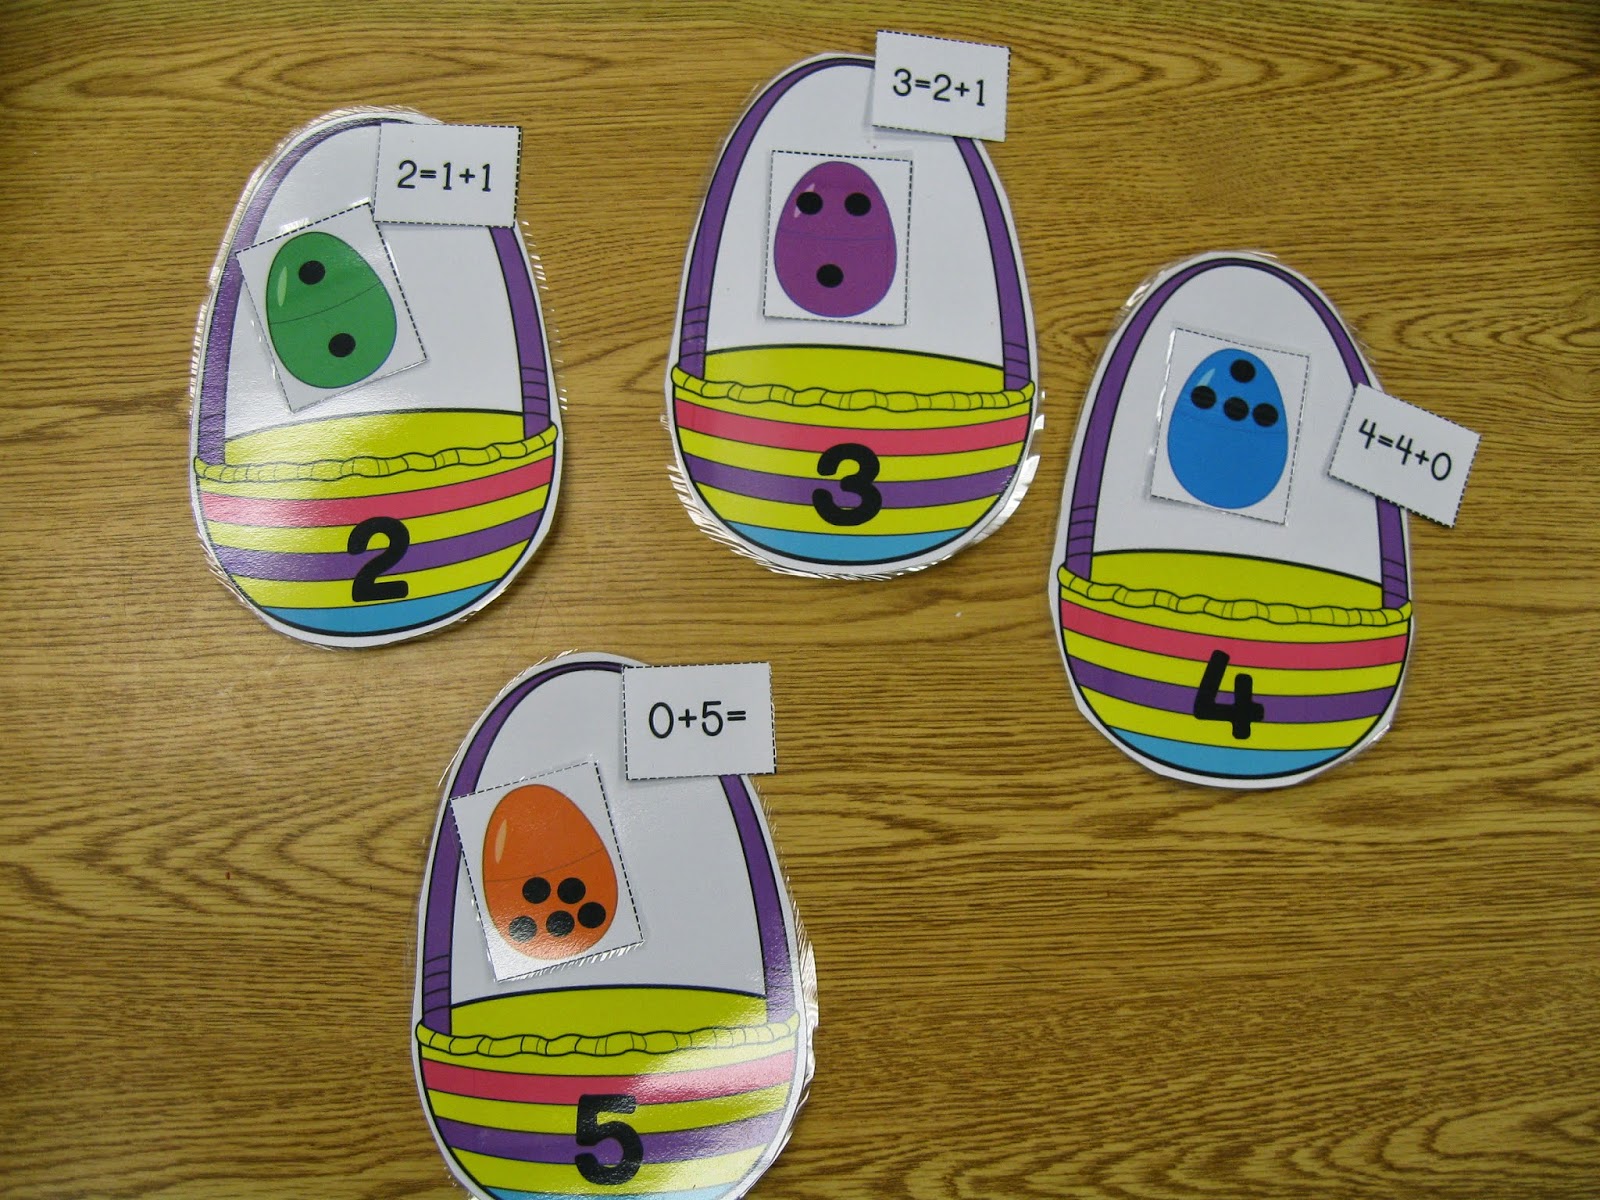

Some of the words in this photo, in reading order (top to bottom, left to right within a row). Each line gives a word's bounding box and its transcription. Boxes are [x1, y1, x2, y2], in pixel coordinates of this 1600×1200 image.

[892, 68, 985, 107] 3=2+1
[397, 159, 491, 192] 2=1+1
[811, 443, 882, 526] 3
[1358, 418, 1452, 481] 4=4+0
[347, 516, 411, 603] 2
[648, 700, 747, 739] 0+5=
[1193, 649, 1265, 740] 4
[574, 1093, 644, 1186] 5
